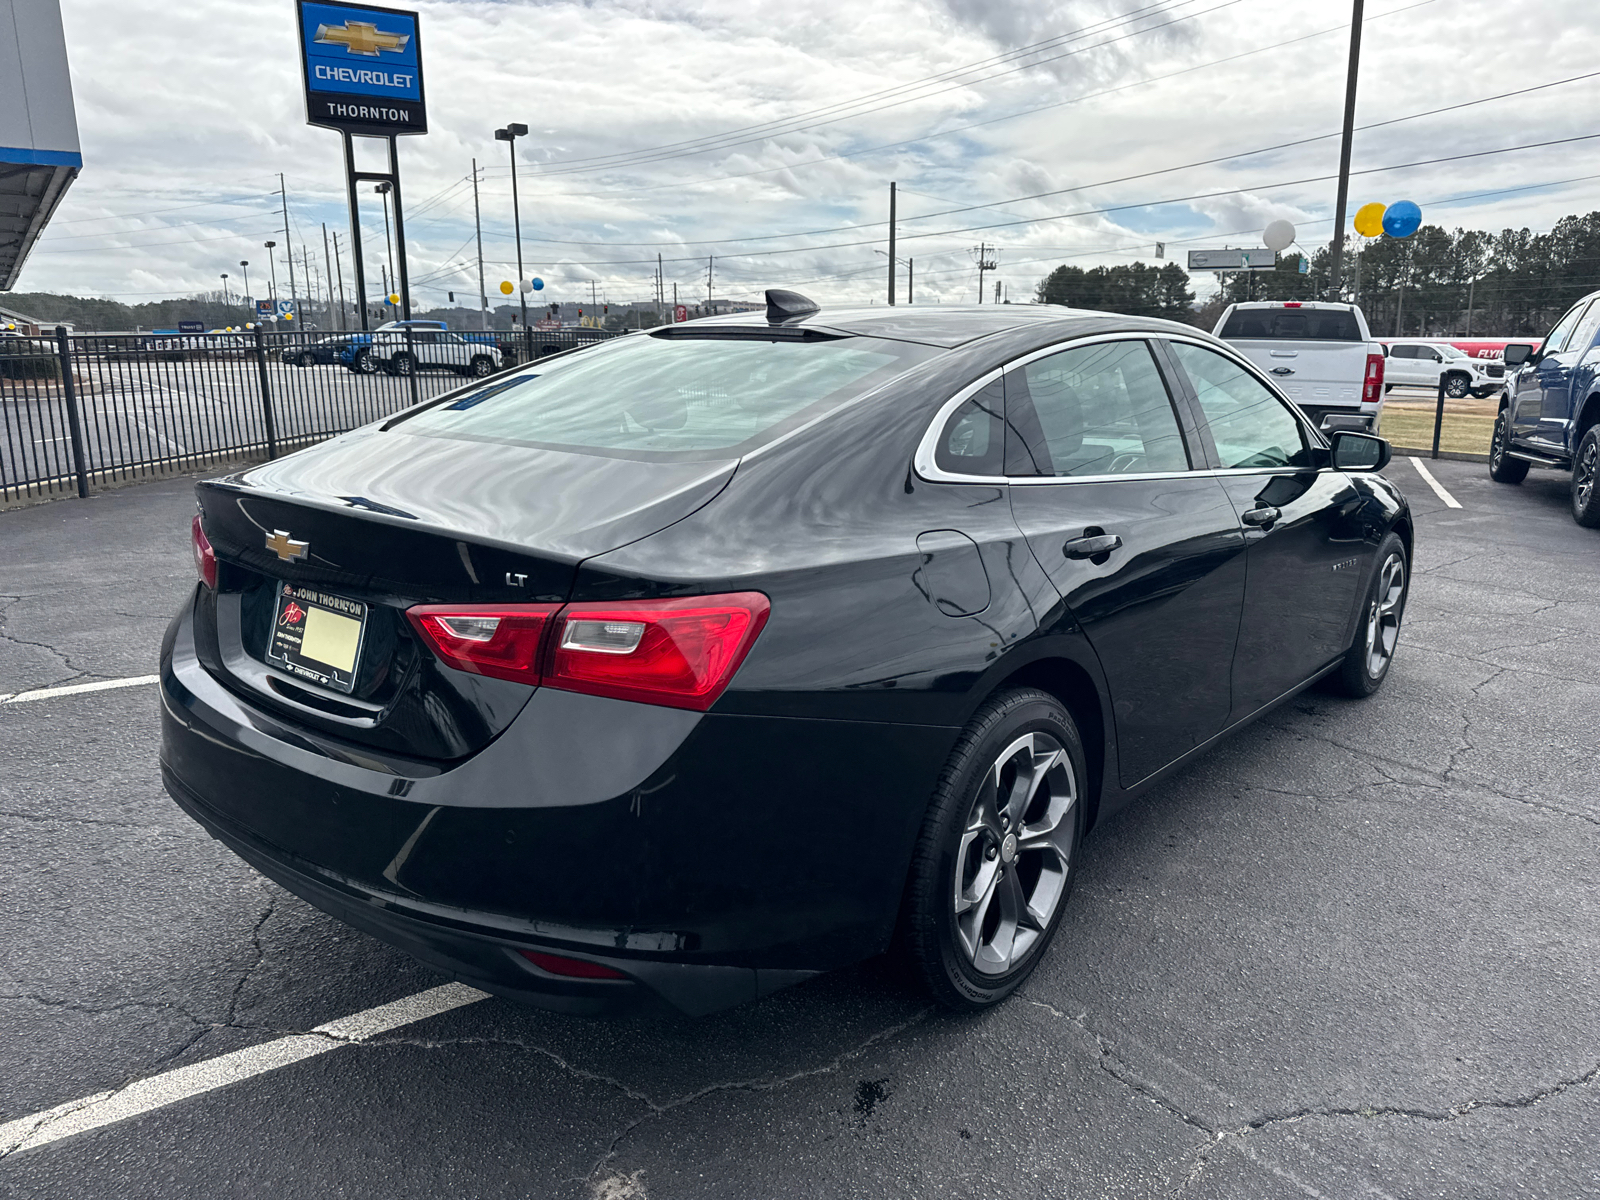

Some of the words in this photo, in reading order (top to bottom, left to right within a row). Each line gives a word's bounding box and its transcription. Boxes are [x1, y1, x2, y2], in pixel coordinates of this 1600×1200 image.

[315, 65, 413, 88] CHEVROLET
[327, 103, 409, 122] THORNTON
[1477, 349, 1505, 360] FLYIN
[1286, 386, 1357, 398] GER
[506, 572, 528, 587] LT
[296, 588, 318, 603] JOHN
[319, 593, 362, 615] THORNTON
[294, 666, 320, 681] CHEVROLET
